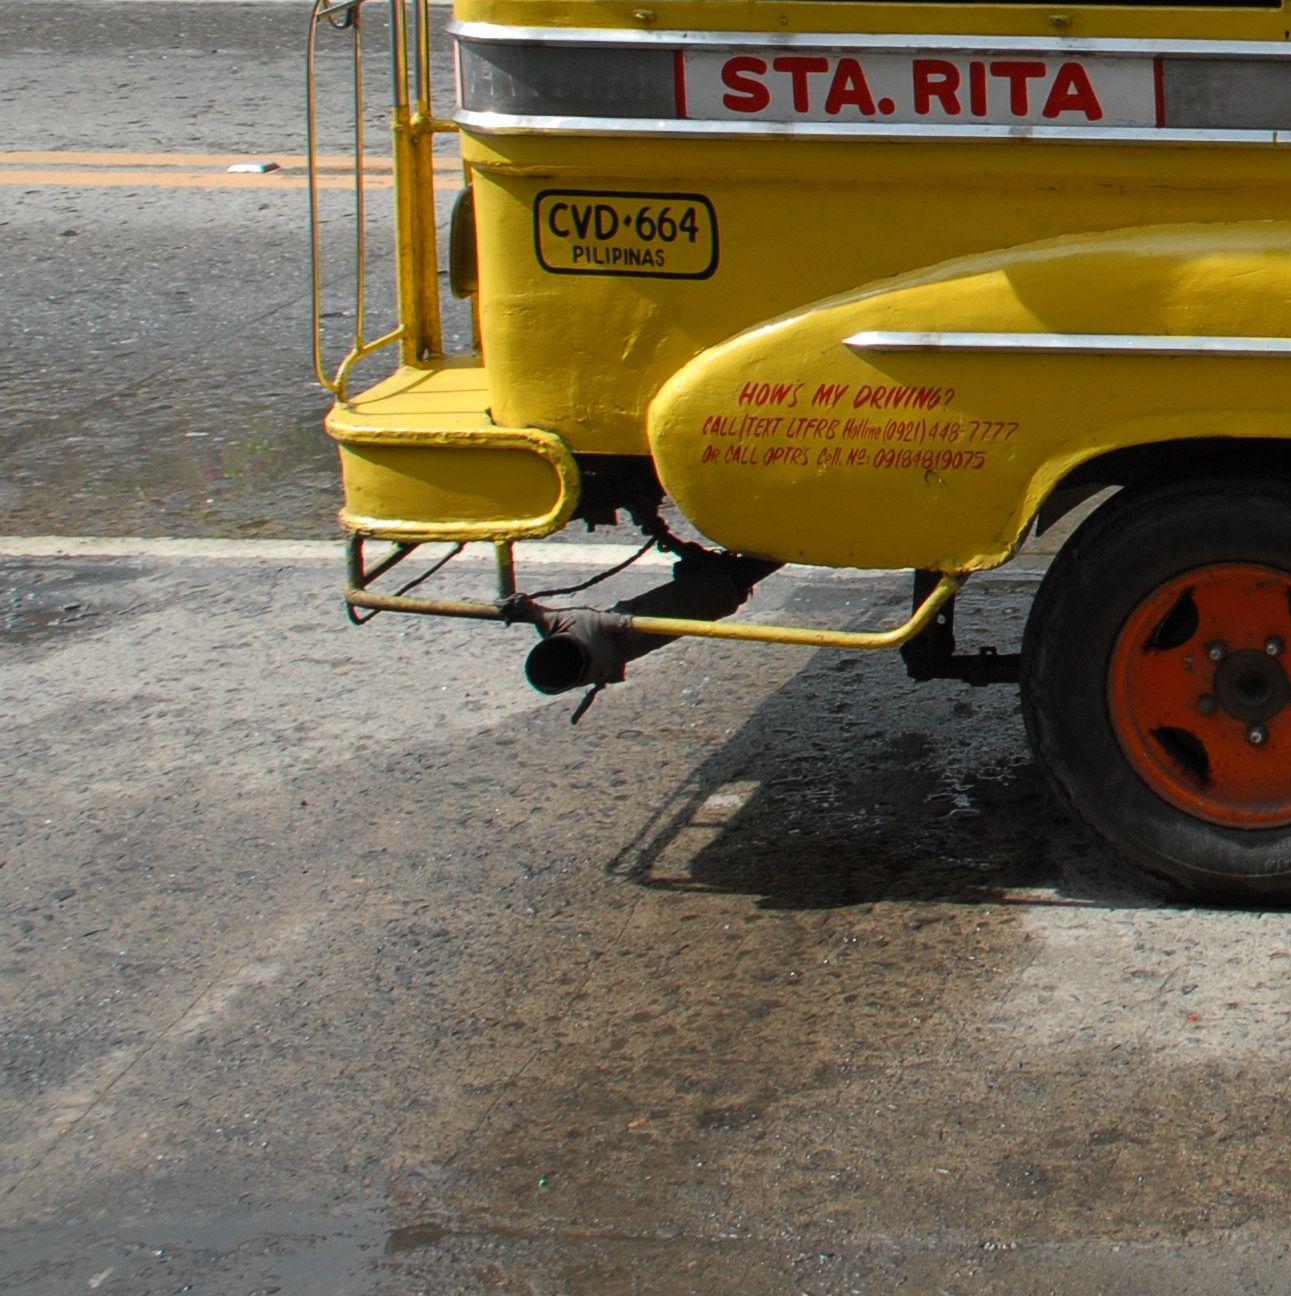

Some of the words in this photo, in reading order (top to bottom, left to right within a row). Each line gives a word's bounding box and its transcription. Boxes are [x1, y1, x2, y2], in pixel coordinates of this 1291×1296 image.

[722, 55, 895, 117] STA.
[912, 58, 1104, 121] RITA
[573, 245, 665, 267] PILIPINAS
[811, 384, 849, 409] MY
[853, 385, 955, 412] DRIVING?
[786, 417, 840, 439] LTFRB
[702, 444, 721, 465] OR
[724, 444, 758, 465] CALL
